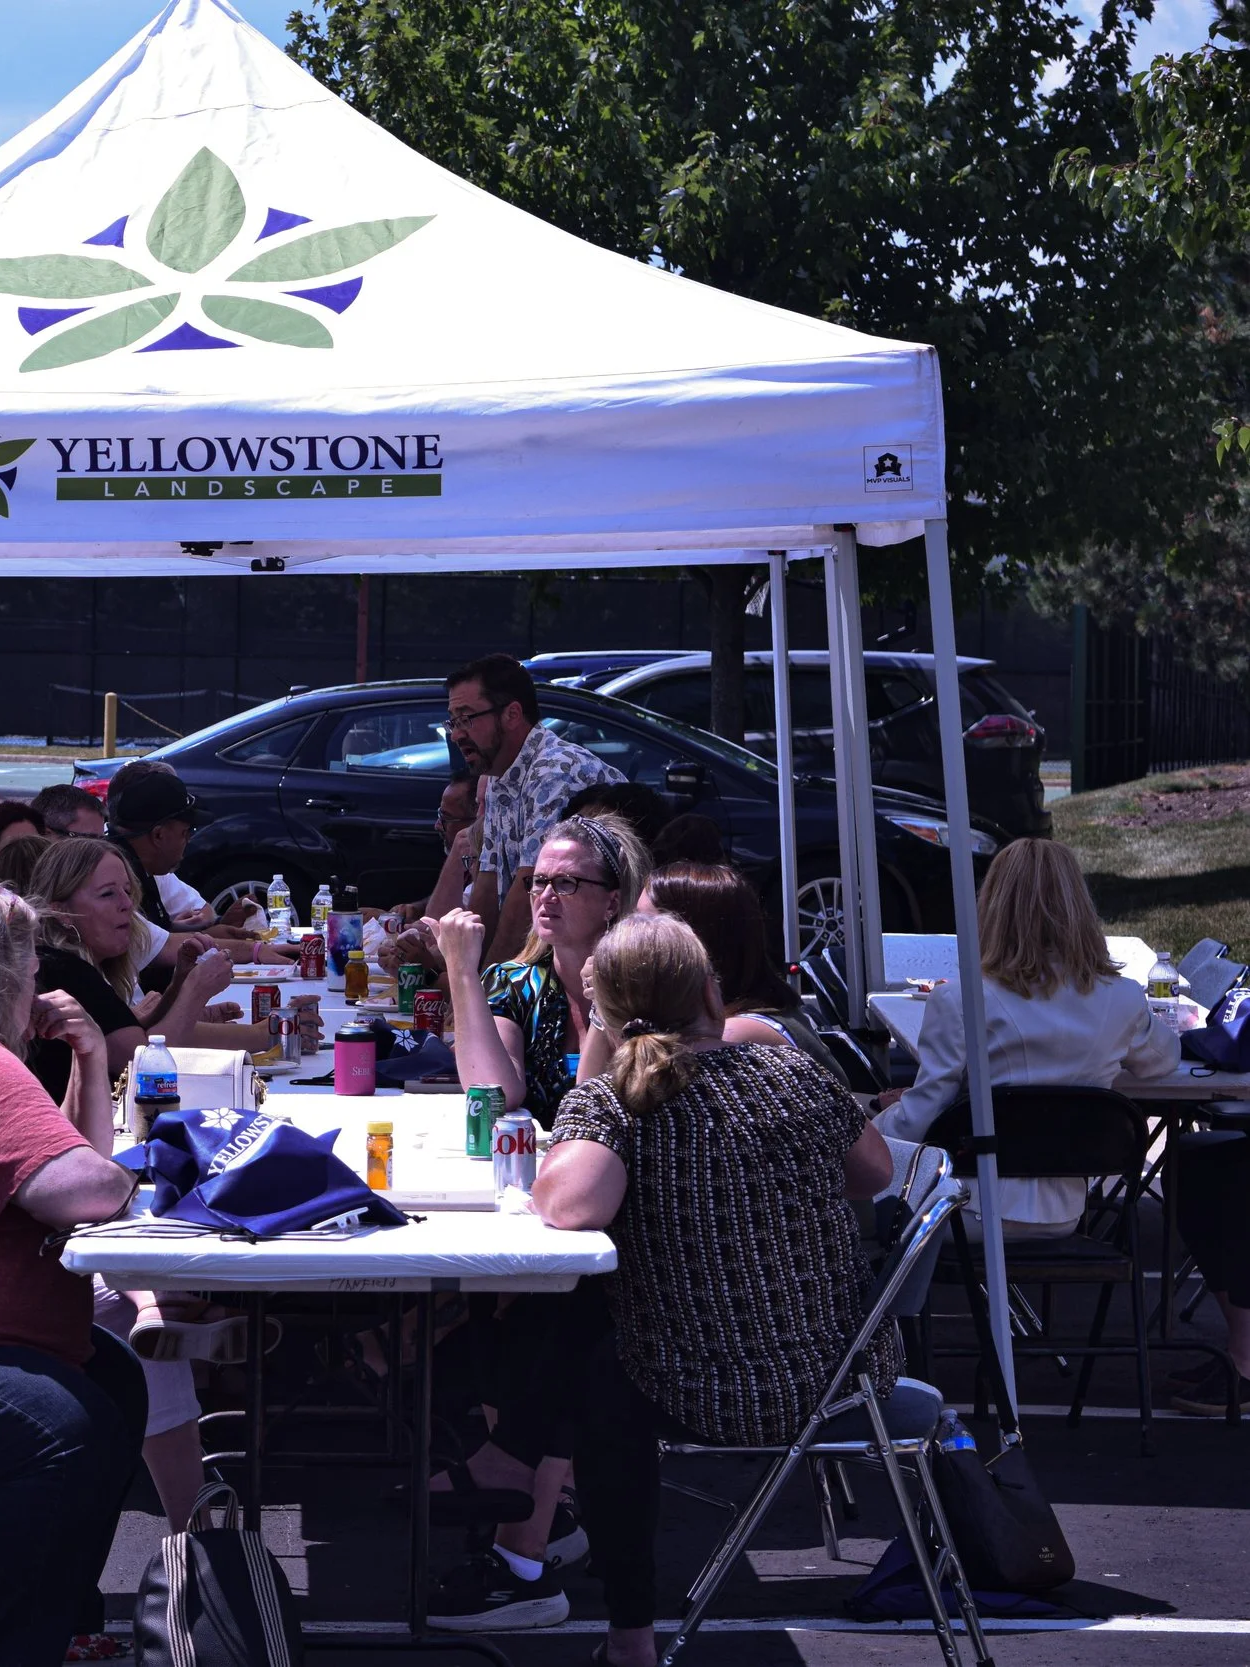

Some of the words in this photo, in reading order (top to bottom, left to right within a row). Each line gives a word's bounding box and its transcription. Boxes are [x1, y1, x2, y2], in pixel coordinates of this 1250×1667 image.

[47, 434, 444, 473] YELLOWSTONE
[104, 479, 393, 497] LANDSCAPE
[268, 1013, 301, 1036] Cok
